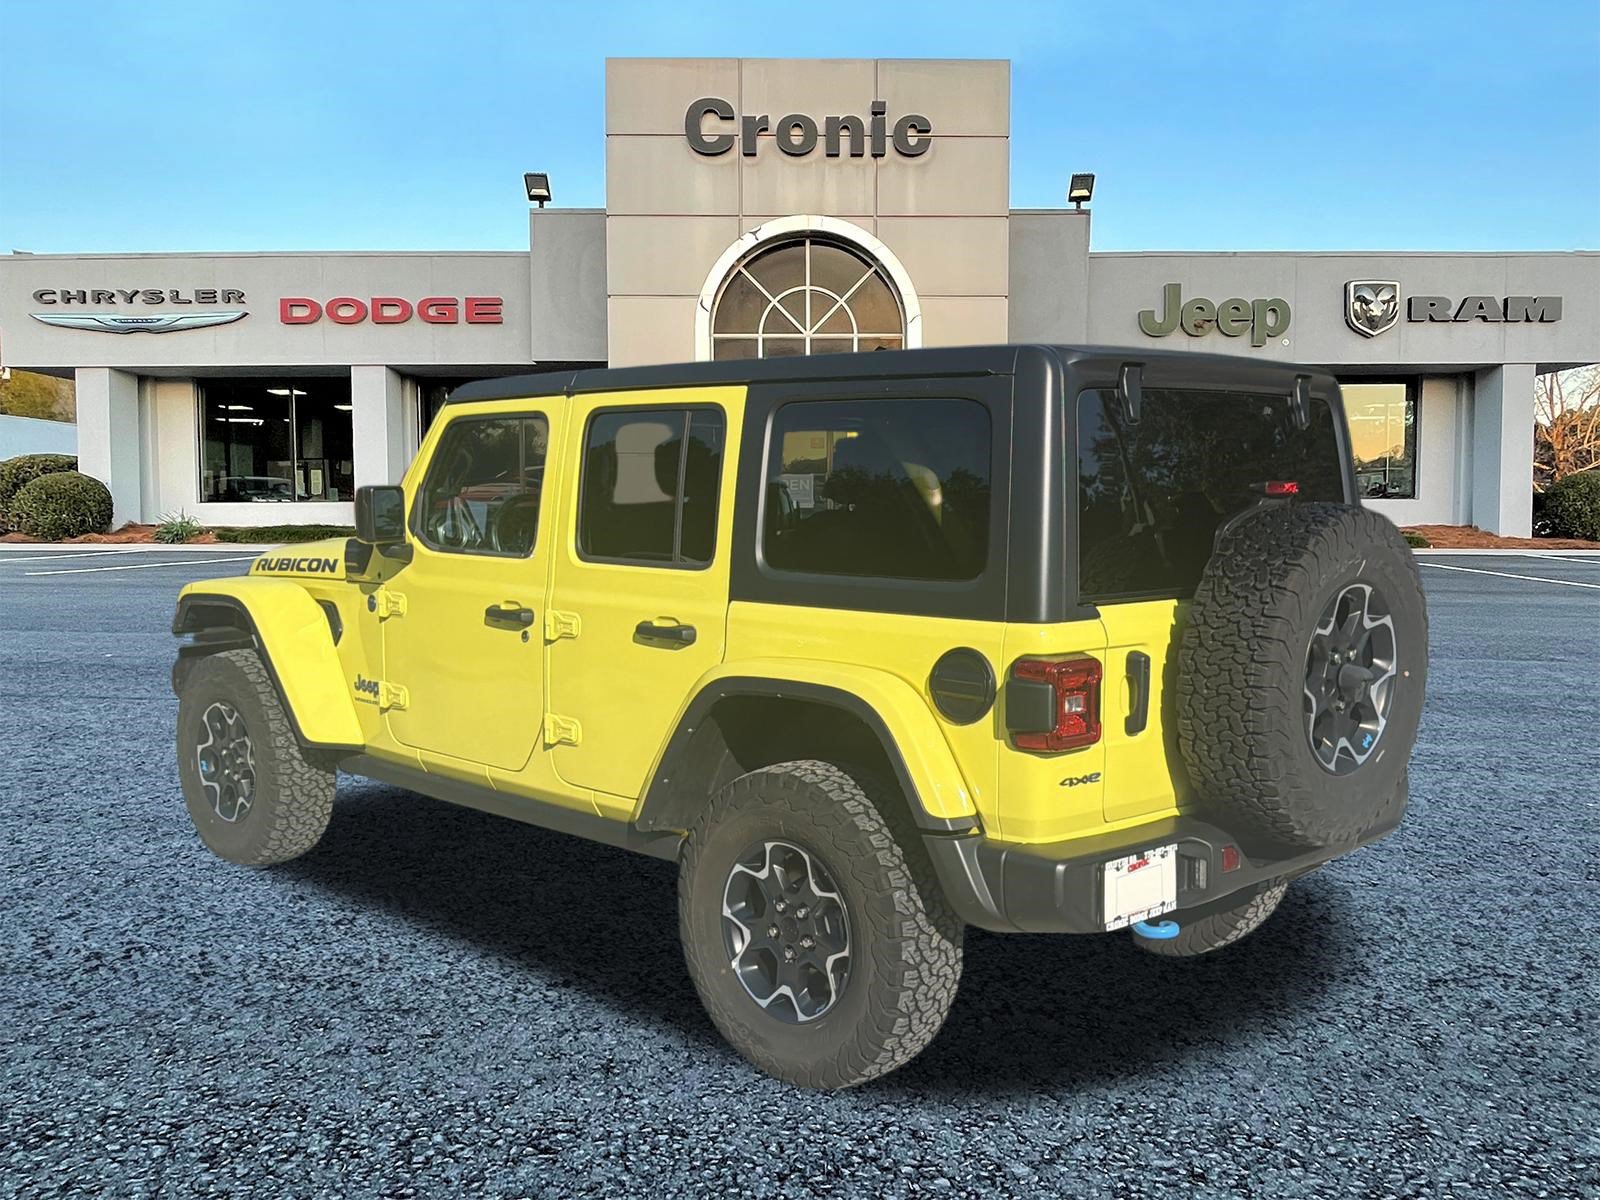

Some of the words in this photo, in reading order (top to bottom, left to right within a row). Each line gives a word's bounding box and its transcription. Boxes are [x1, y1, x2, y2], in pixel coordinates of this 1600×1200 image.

[685, 97, 932, 157] Cronic
[32, 289, 246, 304] CHRYSLER
[1407, 296, 1563, 323] RAM
[280, 297, 503, 325] DODGE
[1138, 283, 1291, 347] Jeep
[255, 558, 340, 573] RUBICON
[354, 673, 379, 698] Jeep
